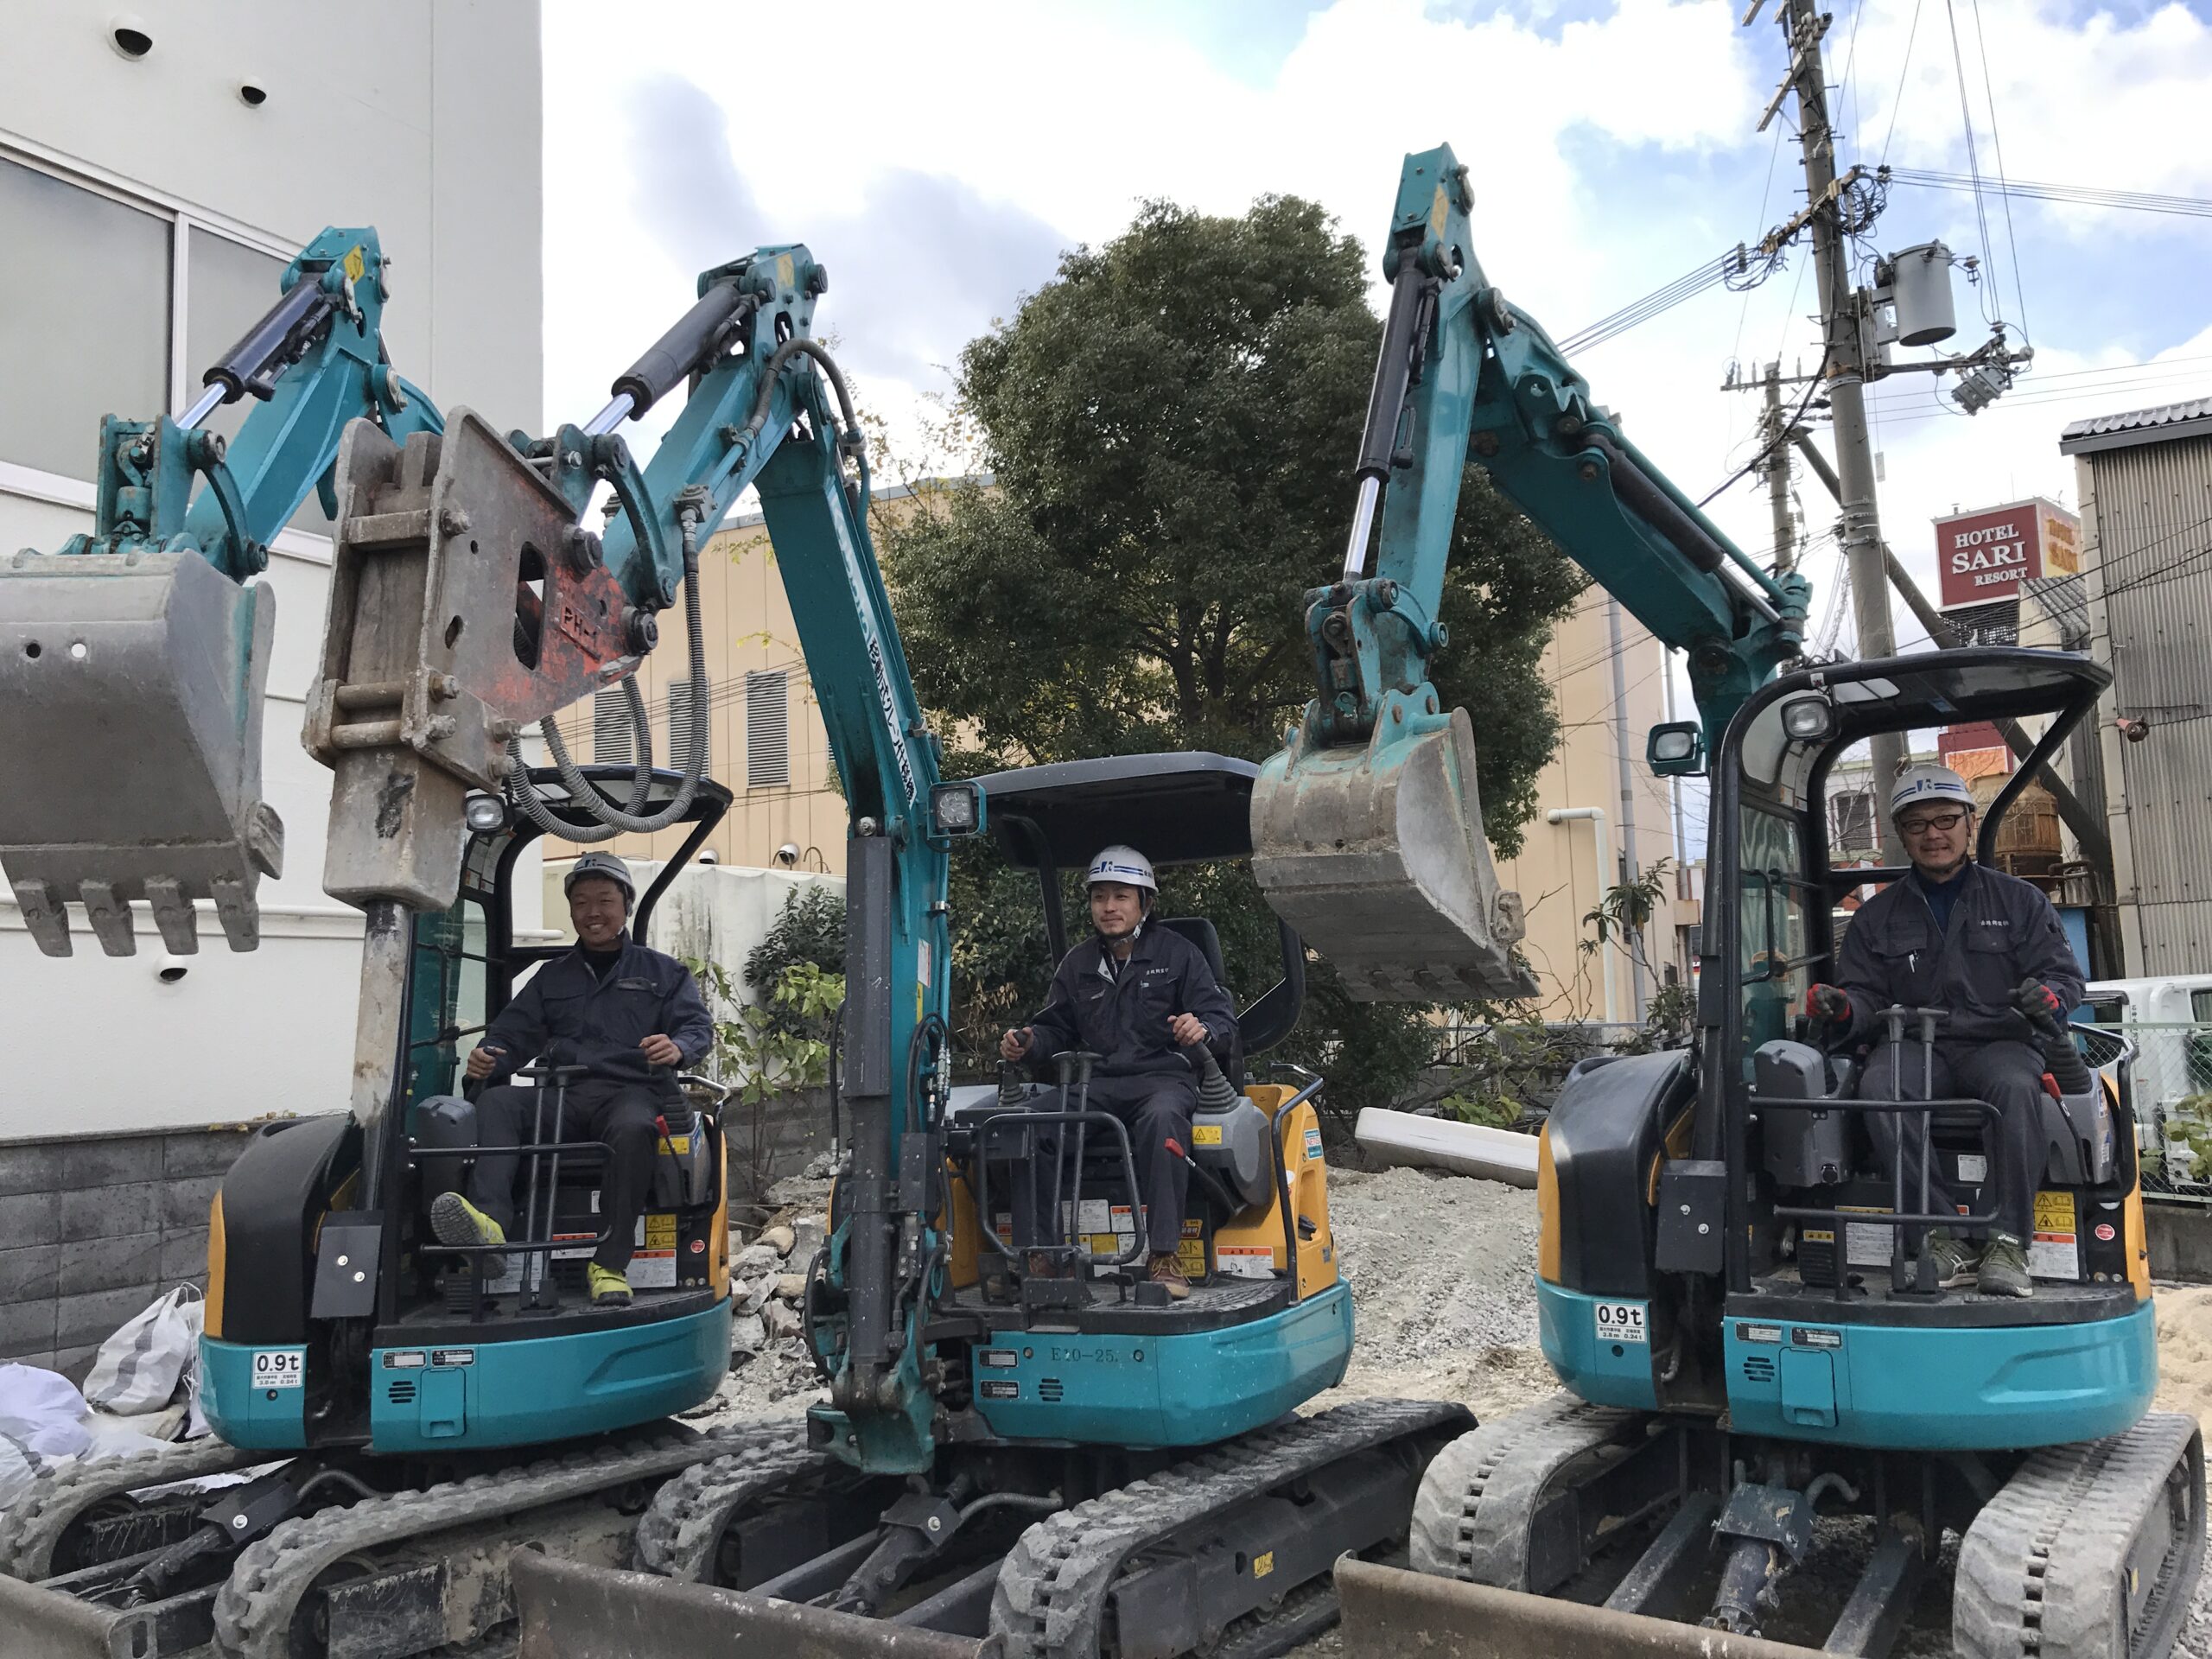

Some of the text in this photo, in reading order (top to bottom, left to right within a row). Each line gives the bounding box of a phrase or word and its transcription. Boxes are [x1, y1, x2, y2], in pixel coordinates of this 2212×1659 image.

[1955, 524, 2019, 549] HOTEL
[1952, 541, 2027, 575] SARI
[1974, 567, 2028, 587] RESORT
